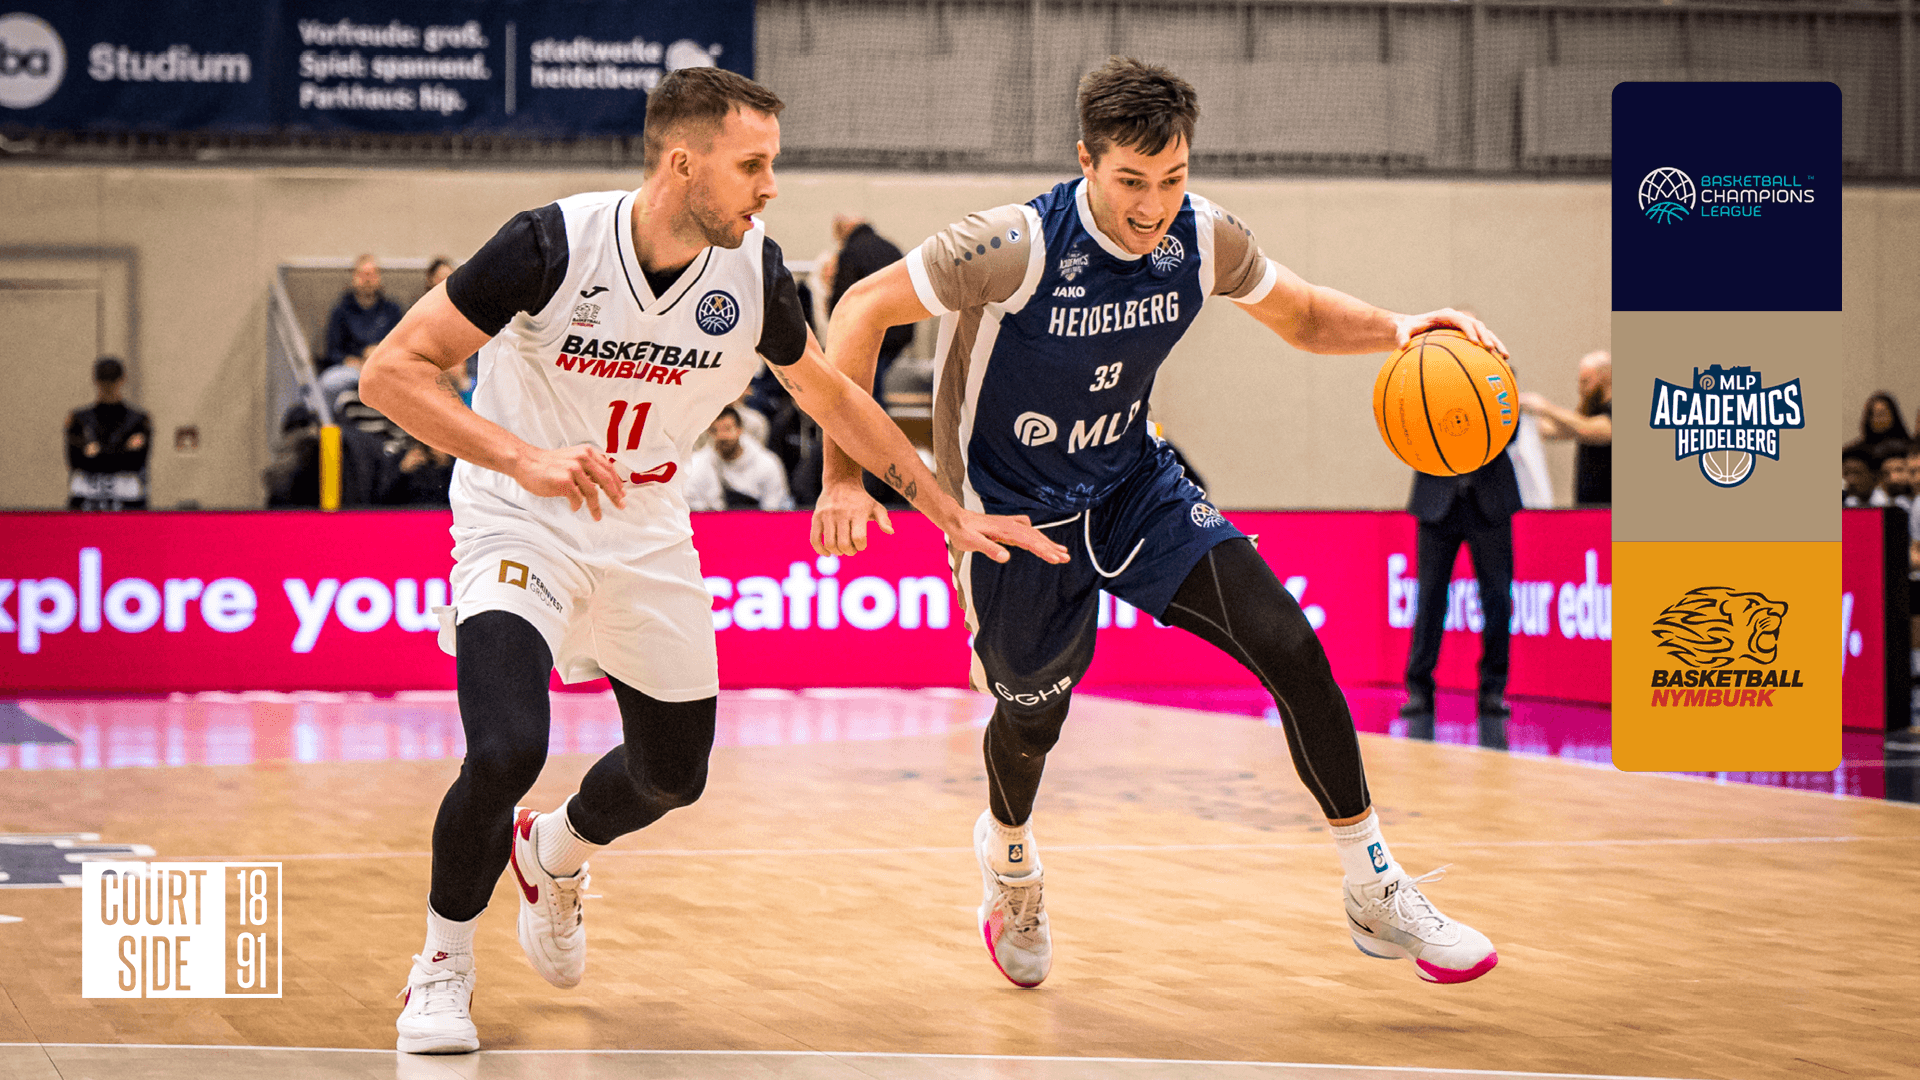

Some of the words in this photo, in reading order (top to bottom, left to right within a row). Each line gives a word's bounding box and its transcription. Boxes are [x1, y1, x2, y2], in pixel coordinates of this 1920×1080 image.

[88, 42, 251, 82] Studium
[531, 36, 663, 63] stadtwerke
[371, 53, 492, 82] spannend.
[531, 63, 661, 94] heidelberg
[420, 83, 467, 115] hip.
[1052, 286, 1086, 298] JAKO
[1048, 291, 1179, 337] HEIDELBERG
[560, 334, 723, 369] BASKETBALL
[555, 353, 690, 386] NYMBURK
[1089, 361, 1123, 392] 33
[605, 399, 652, 454] 11
[531, 573, 563, 613] PERINVEST
[282, 577, 453, 654] you
[995, 682, 1061, 706] GGH
